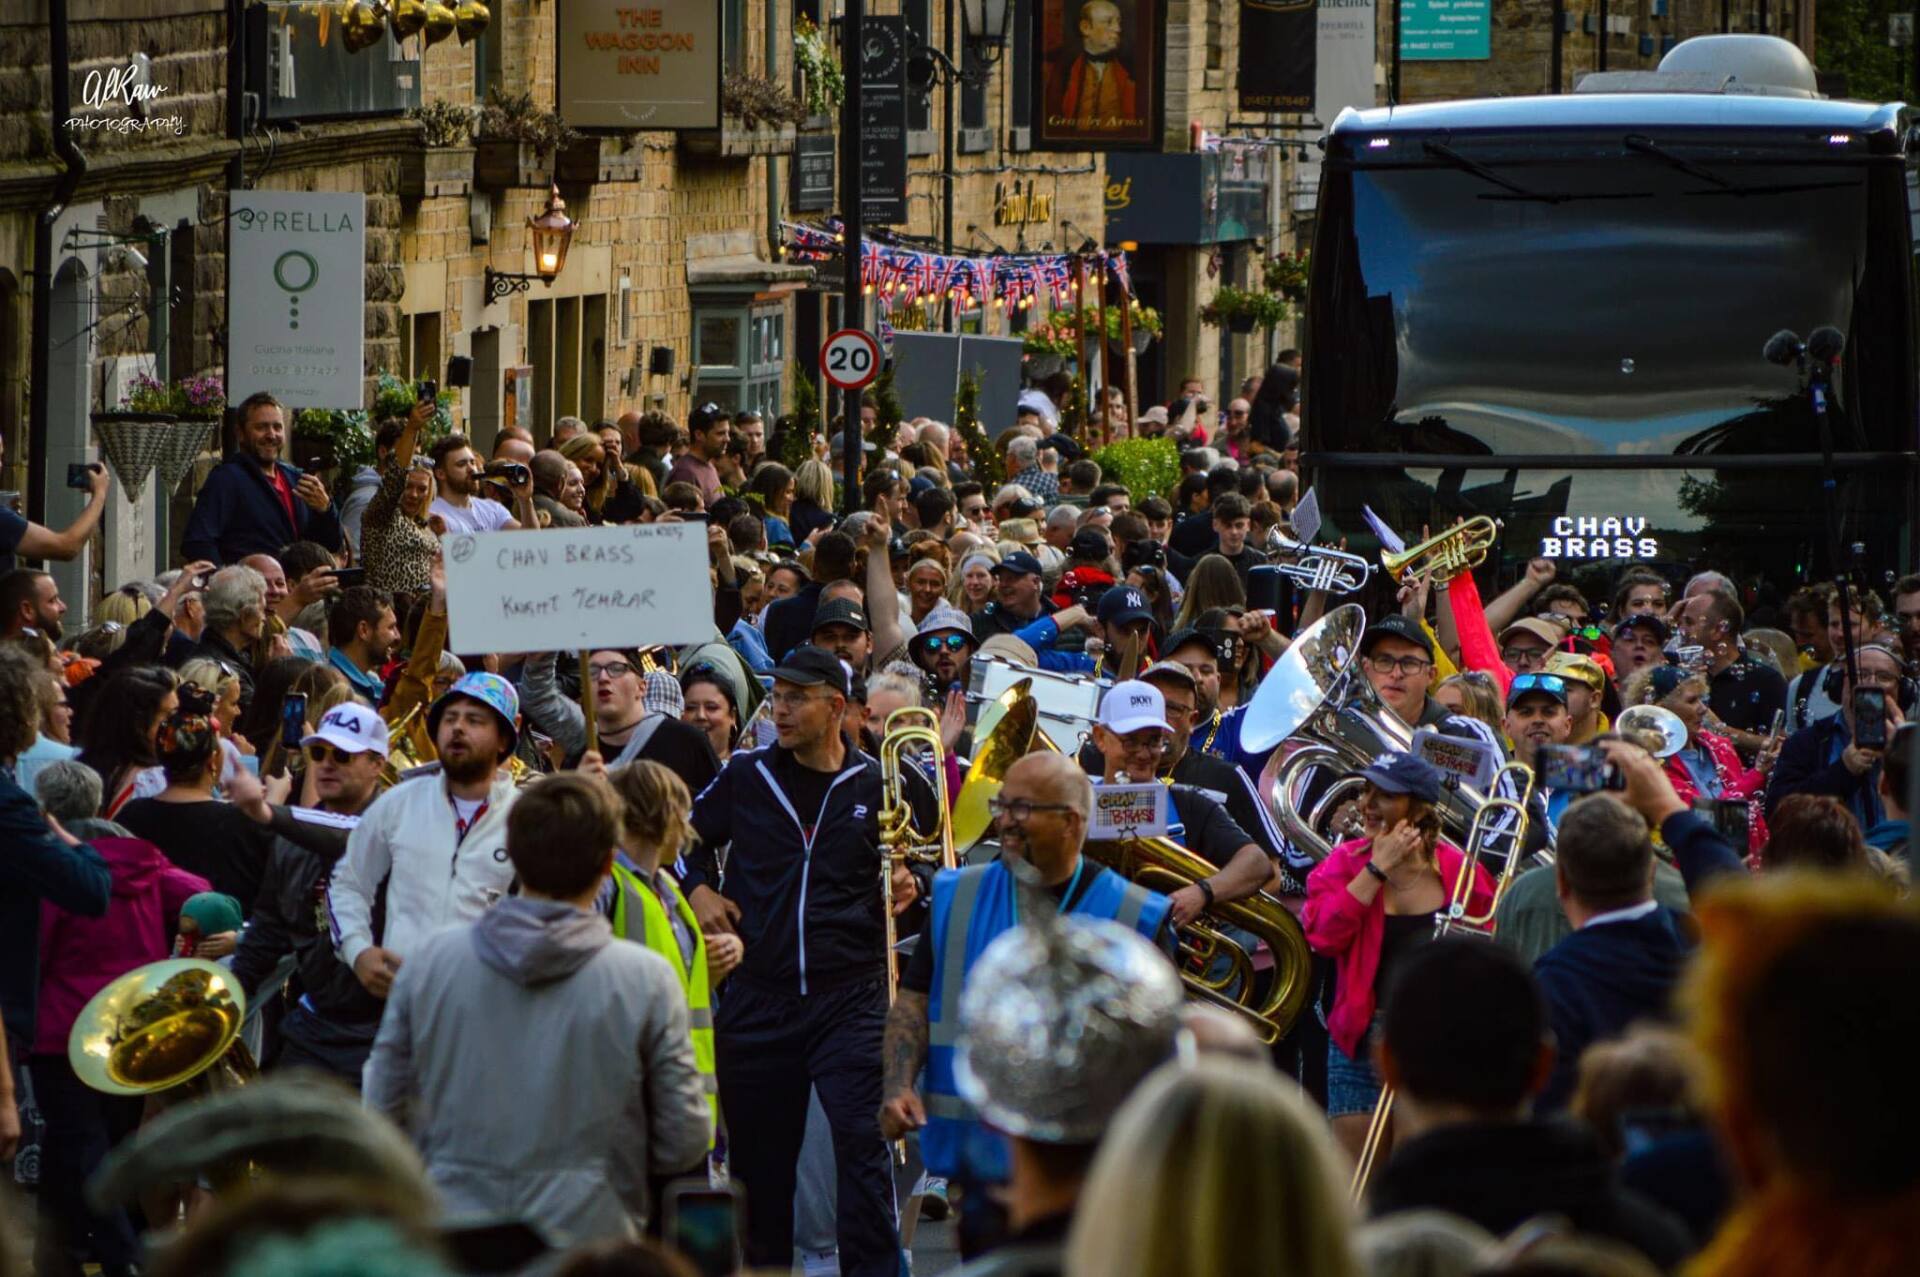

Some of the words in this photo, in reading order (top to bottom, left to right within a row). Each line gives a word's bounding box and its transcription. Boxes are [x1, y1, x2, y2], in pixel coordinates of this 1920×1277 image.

[616, 9, 662, 27] THE
[585, 32, 694, 50] WAGGON
[617, 56, 660, 74] INN
[830, 347, 871, 371] 20
[1554, 516, 1646, 536] CHAV
[497, 547, 549, 570] CHAV
[565, 543, 636, 565] BRASS
[1542, 537, 1658, 557] BRASS
[1130, 695, 1152, 704] DKNY
